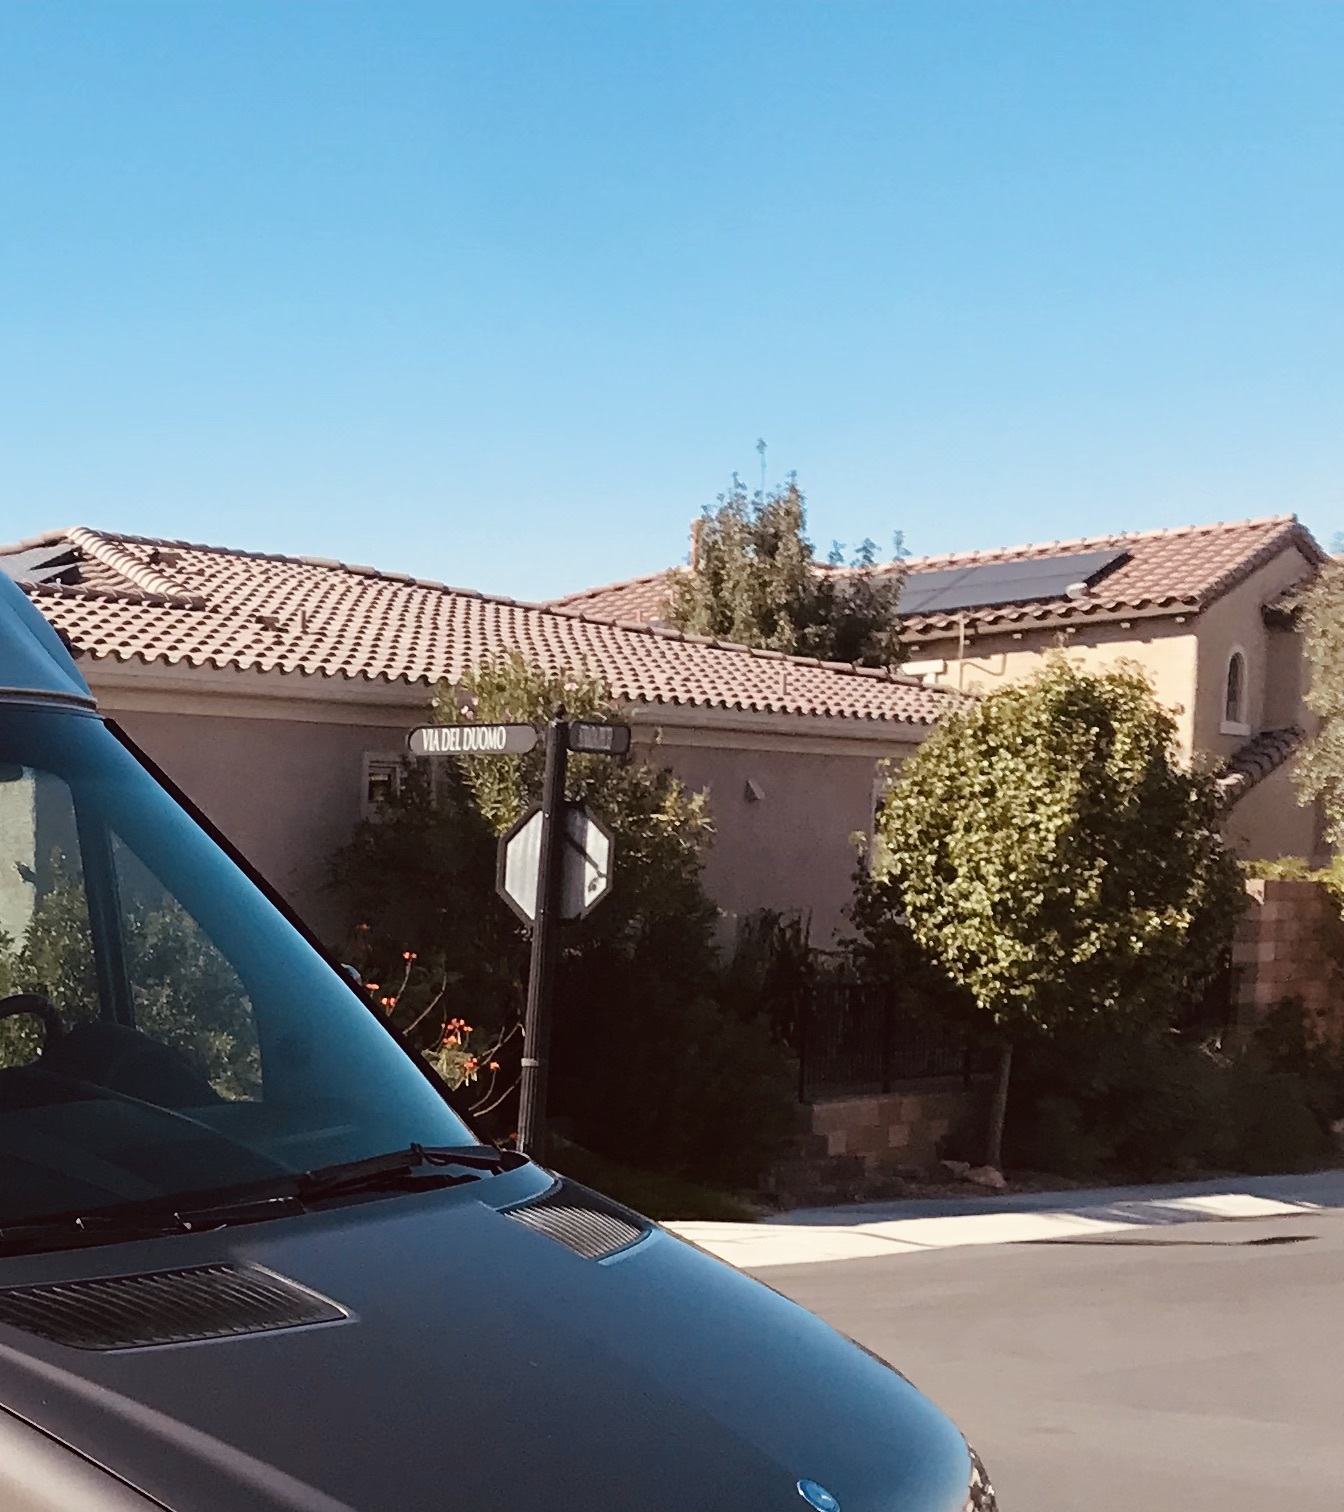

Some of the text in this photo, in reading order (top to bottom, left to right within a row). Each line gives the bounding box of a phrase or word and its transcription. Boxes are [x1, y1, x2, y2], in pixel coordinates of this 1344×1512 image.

[422, 726, 506, 751] VIA DEL DUOMO
